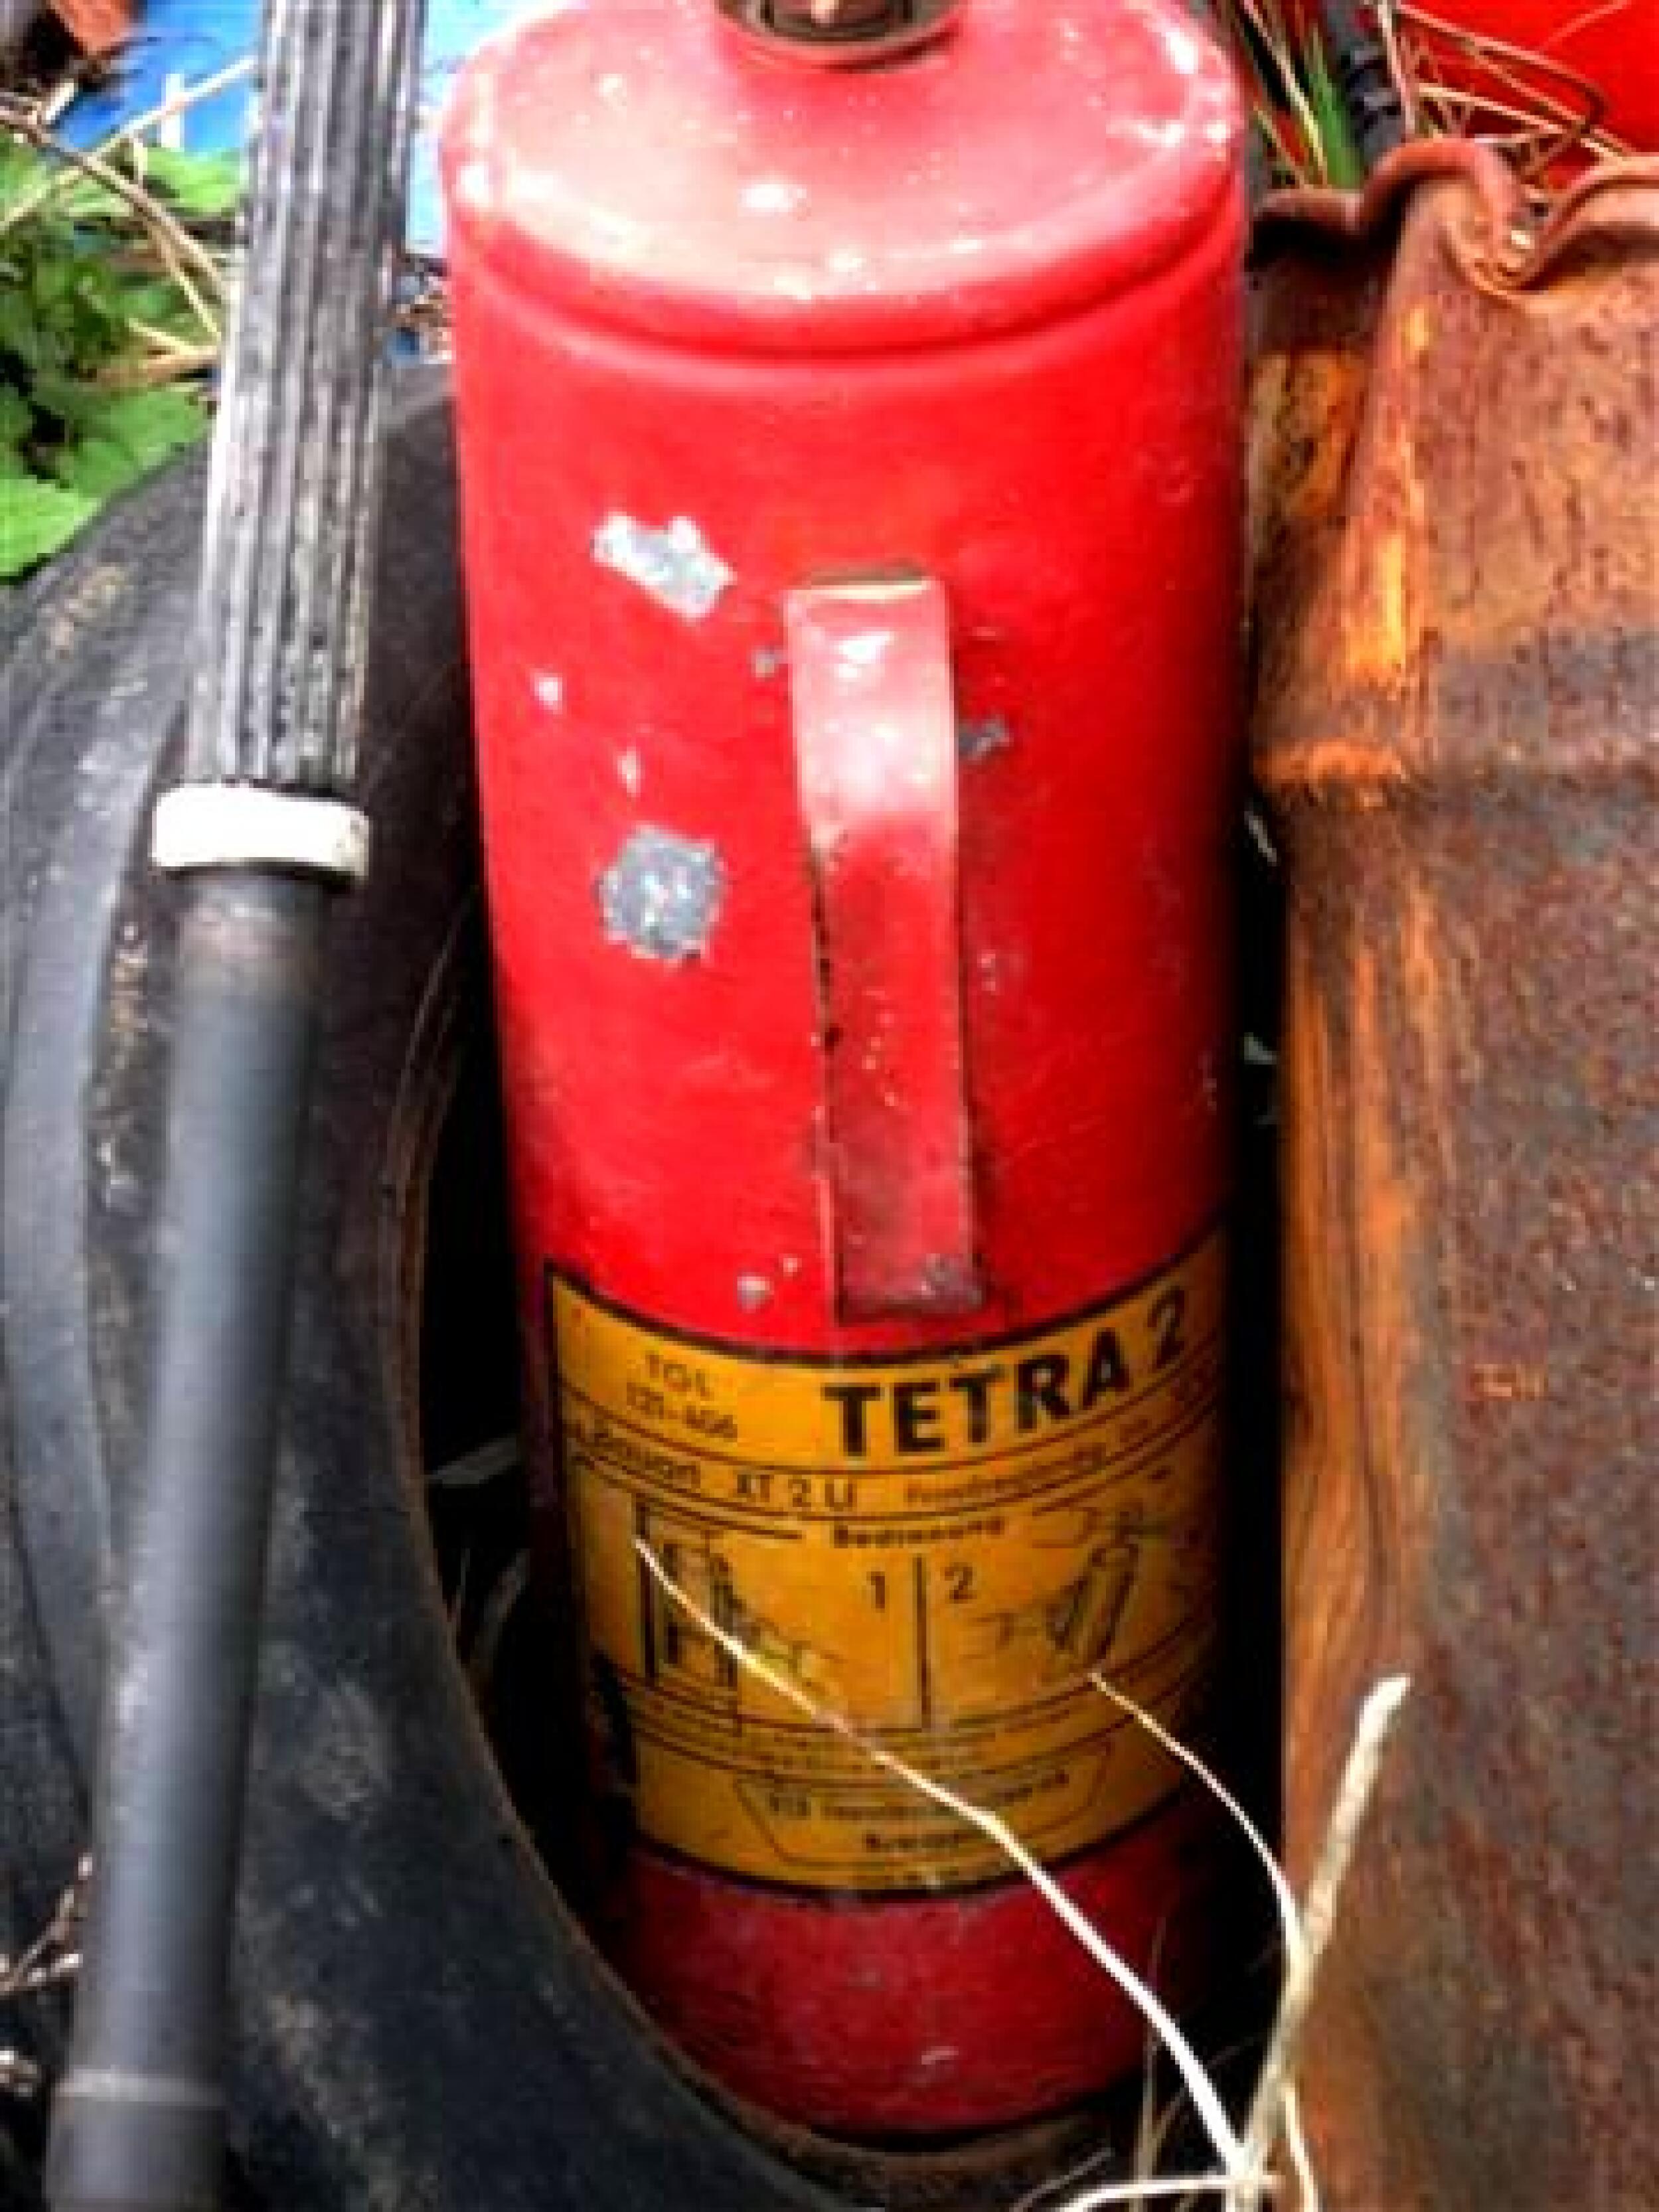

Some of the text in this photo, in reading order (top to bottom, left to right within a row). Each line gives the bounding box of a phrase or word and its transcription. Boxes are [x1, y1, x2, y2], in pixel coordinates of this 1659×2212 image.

[822, 1288, 1186, 1457] TETRA 2
[867, 1562, 977, 1613] 1 2
